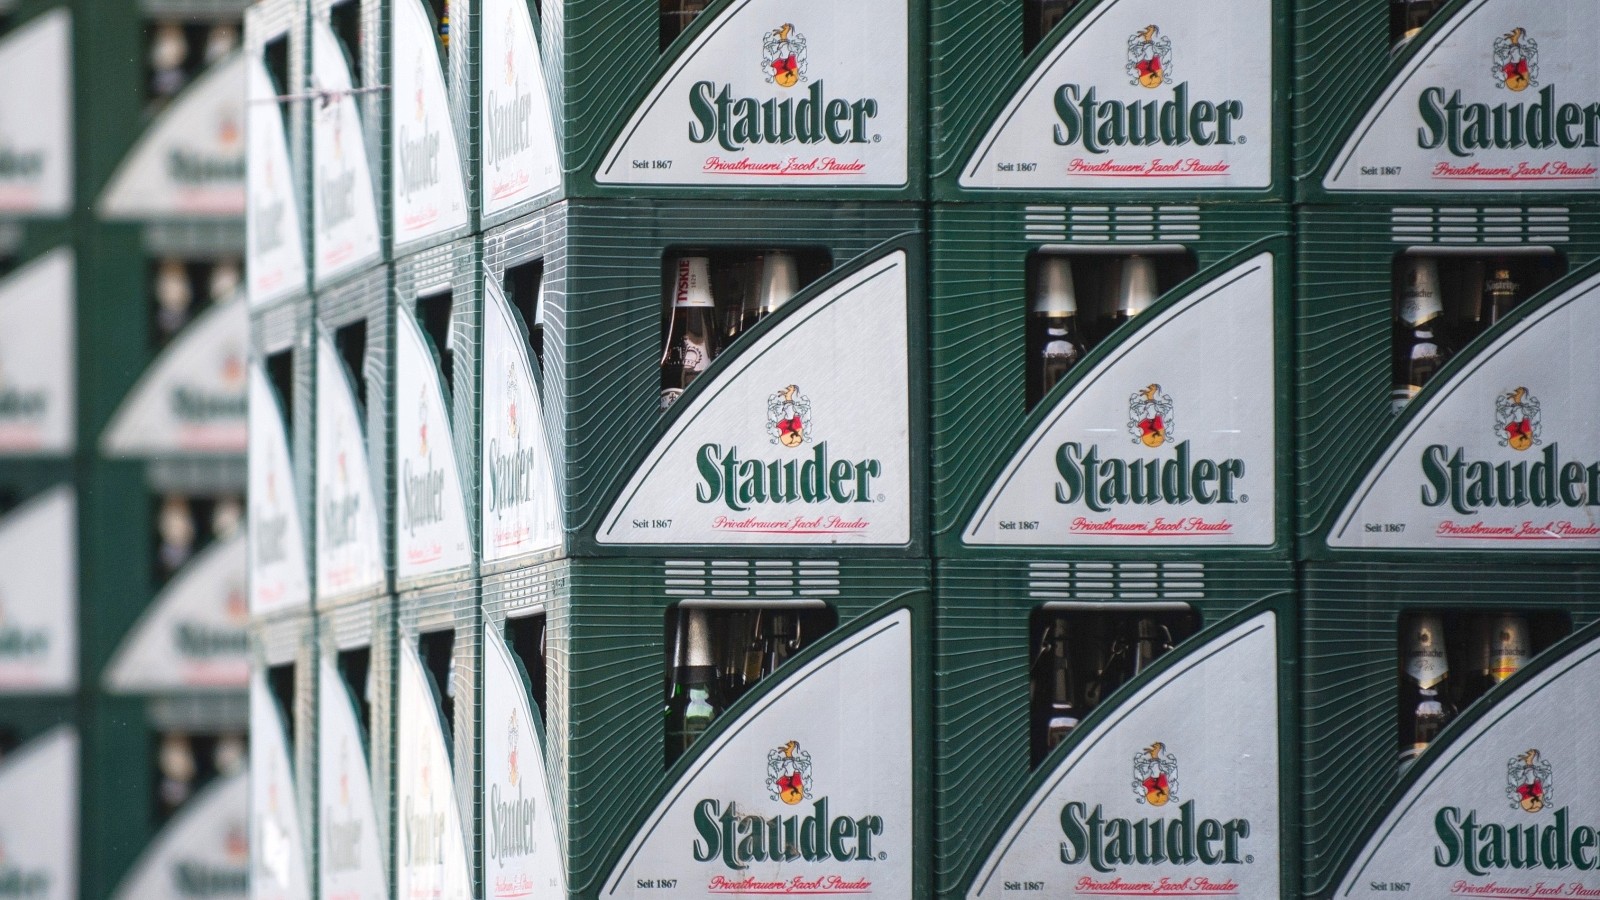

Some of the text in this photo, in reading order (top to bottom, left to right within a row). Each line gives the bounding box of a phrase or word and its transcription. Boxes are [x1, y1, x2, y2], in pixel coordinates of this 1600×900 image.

[689, 79, 878, 152] Stauder
[1054, 81, 1243, 154] Stauder
[633, 160, 672, 169] Seit 1867
[703, 157, 866, 173] Privatbrauerei Jacob Stauder
[998, 163, 1037, 171] Seit 1867
[1068, 158, 1230, 174] Privatbrauerei Jacob Stauder
[1361, 166, 1401, 175] Seit 1867
[1432, 161, 1598, 178] Privatbrauerei Jacob Stauder
[678, 260, 689, 303] TYSKIE
[696, 441, 881, 511] Stauder
[1056, 440, 1245, 513] Stauder
[633, 520, 672, 528] Seit 1867
[712, 515, 870, 530] Privatbrauerei Jacob Stauder
[1000, 521, 1039, 529] Seit 1867
[1070, 517, 1232, 534] Privatbrauerei Jacob Stauder
[1365, 523, 1405, 532] Seit 1867
[1437, 520, 1517, 534] Privatbrauerei
[693, 796, 883, 870] Stauder
[1060, 800, 1250, 873] Stauder
[1435, 806, 1600, 876] Staude
[637, 880, 677, 888] Seit 1867
[708, 875, 871, 892] Privatbrauerei Jacob Stauder
[1004, 881, 1044, 890] Seit 1867
[1075, 876, 1238, 893] Privatbrauerei Jacob Stauder
[1371, 881, 1410, 891] Seit 1867
[1450, 880, 1531, 894] Privatbrauerei
[1531, 881, 1565, 896] Jacob
